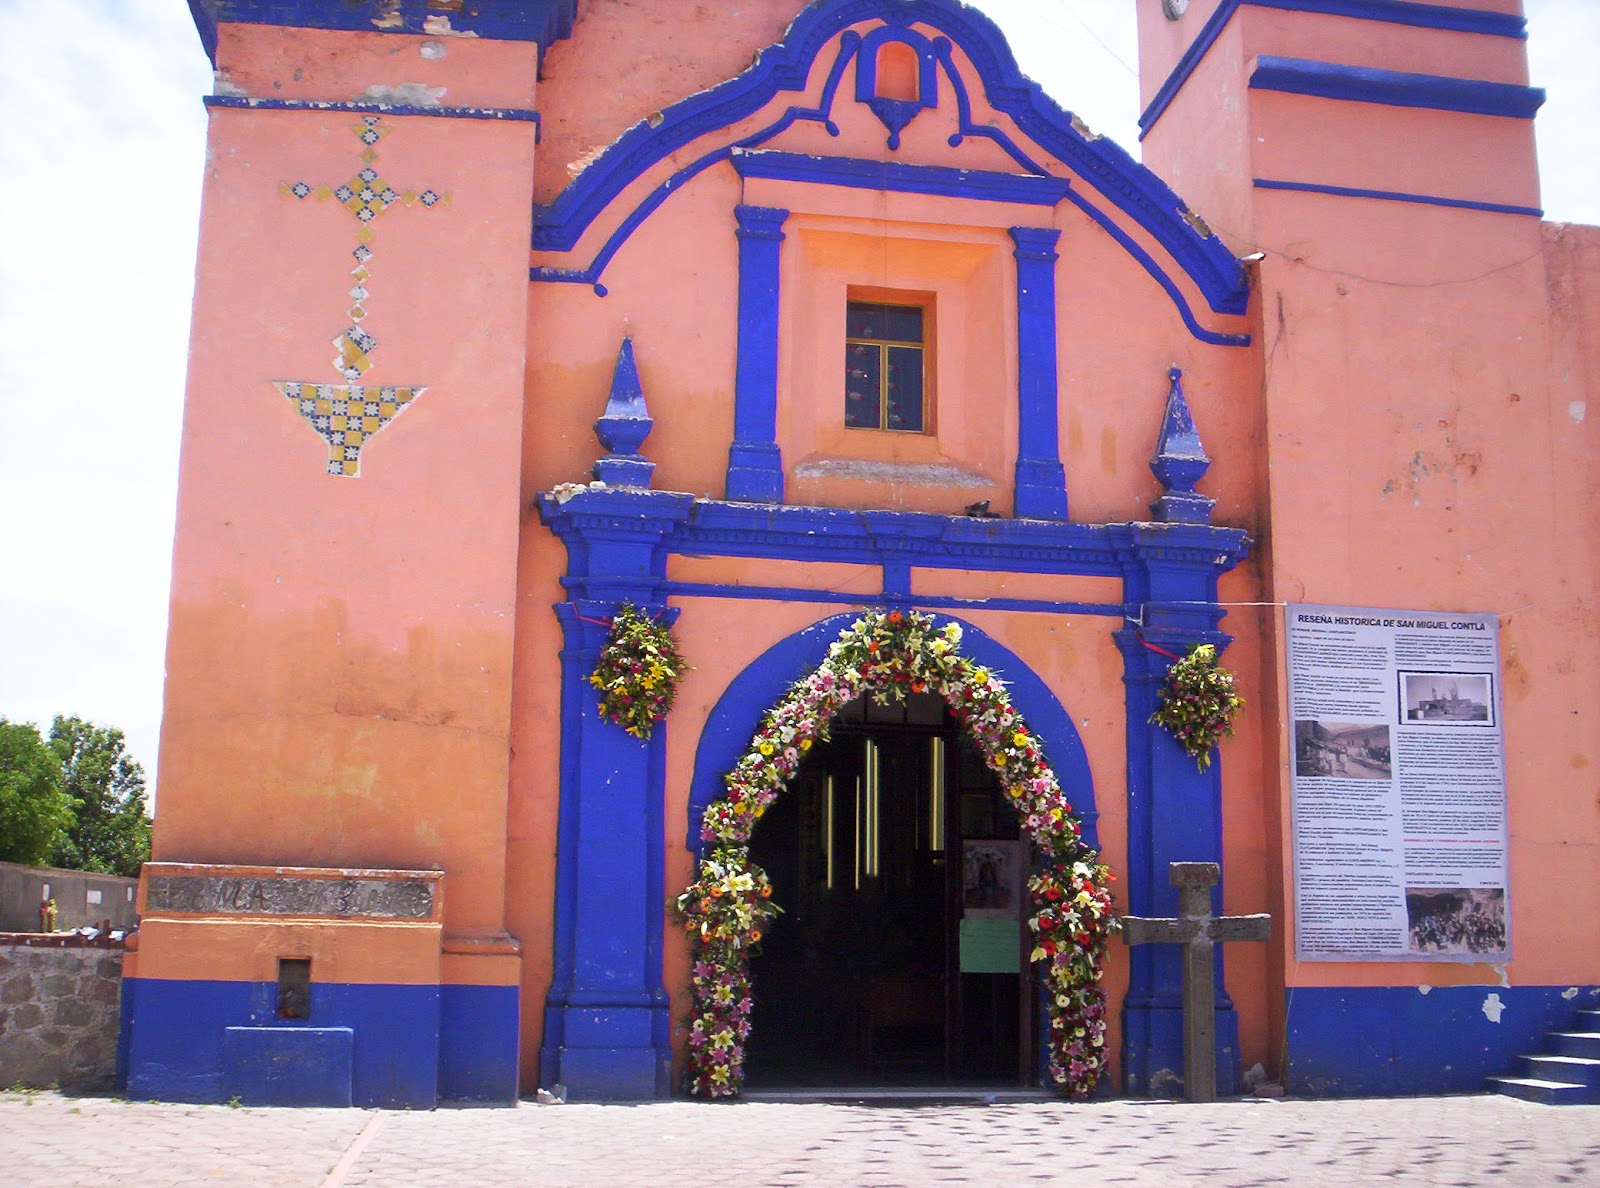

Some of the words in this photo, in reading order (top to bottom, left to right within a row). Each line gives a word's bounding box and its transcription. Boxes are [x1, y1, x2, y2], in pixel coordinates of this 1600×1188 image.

[1298, 614, 1333, 624] RESEÑA
[1335, 617, 1381, 627] HISTORICA
[1383, 619, 1395, 627] DE
[1396, 620, 1414, 628] SAN
[1416, 620, 1449, 629] MIGUEL
[1450, 622, 1486, 631] CONTLA
